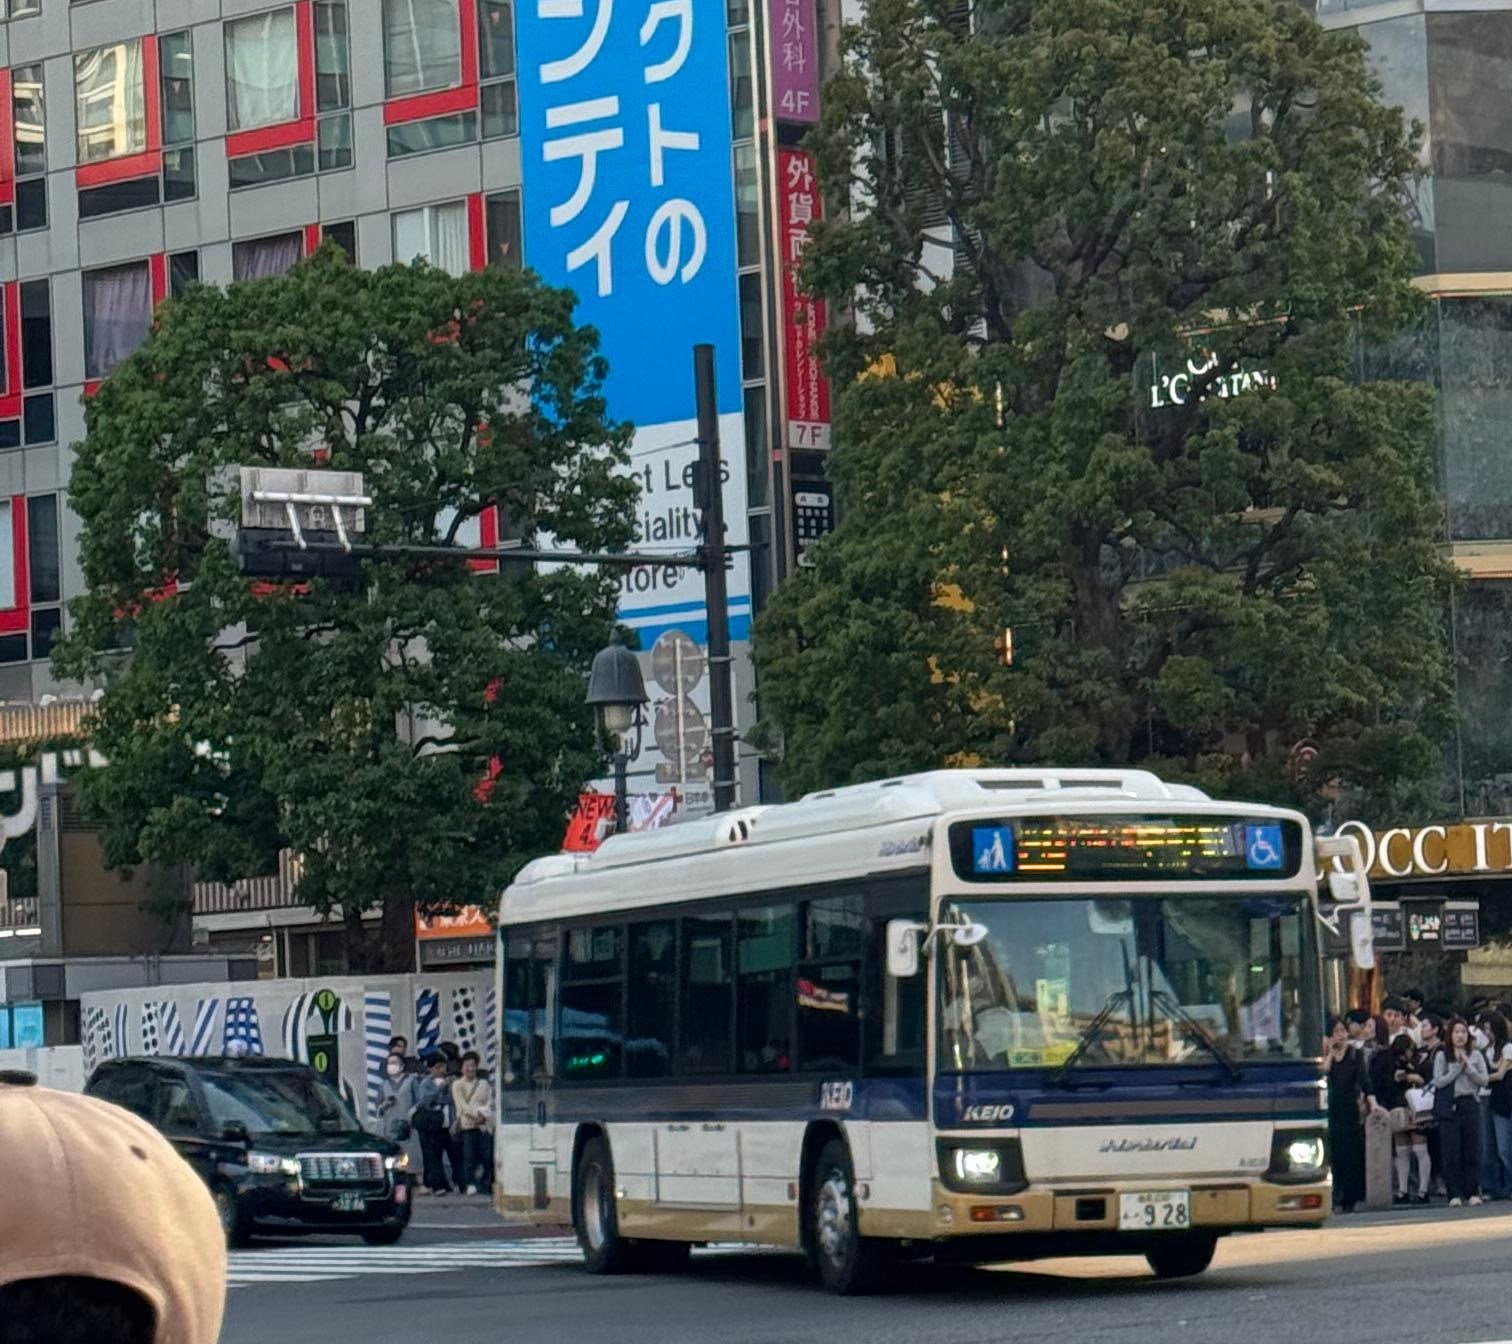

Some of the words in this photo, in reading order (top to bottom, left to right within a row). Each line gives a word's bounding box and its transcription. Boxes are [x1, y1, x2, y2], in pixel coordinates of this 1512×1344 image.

[781, 89, 810, 113] 4F
[795, 425, 823, 446] 7F
[664, 458, 730, 493] Les
[820, 1081, 852, 1109] KEIO
[963, 1103, 1015, 1121] KEIO
